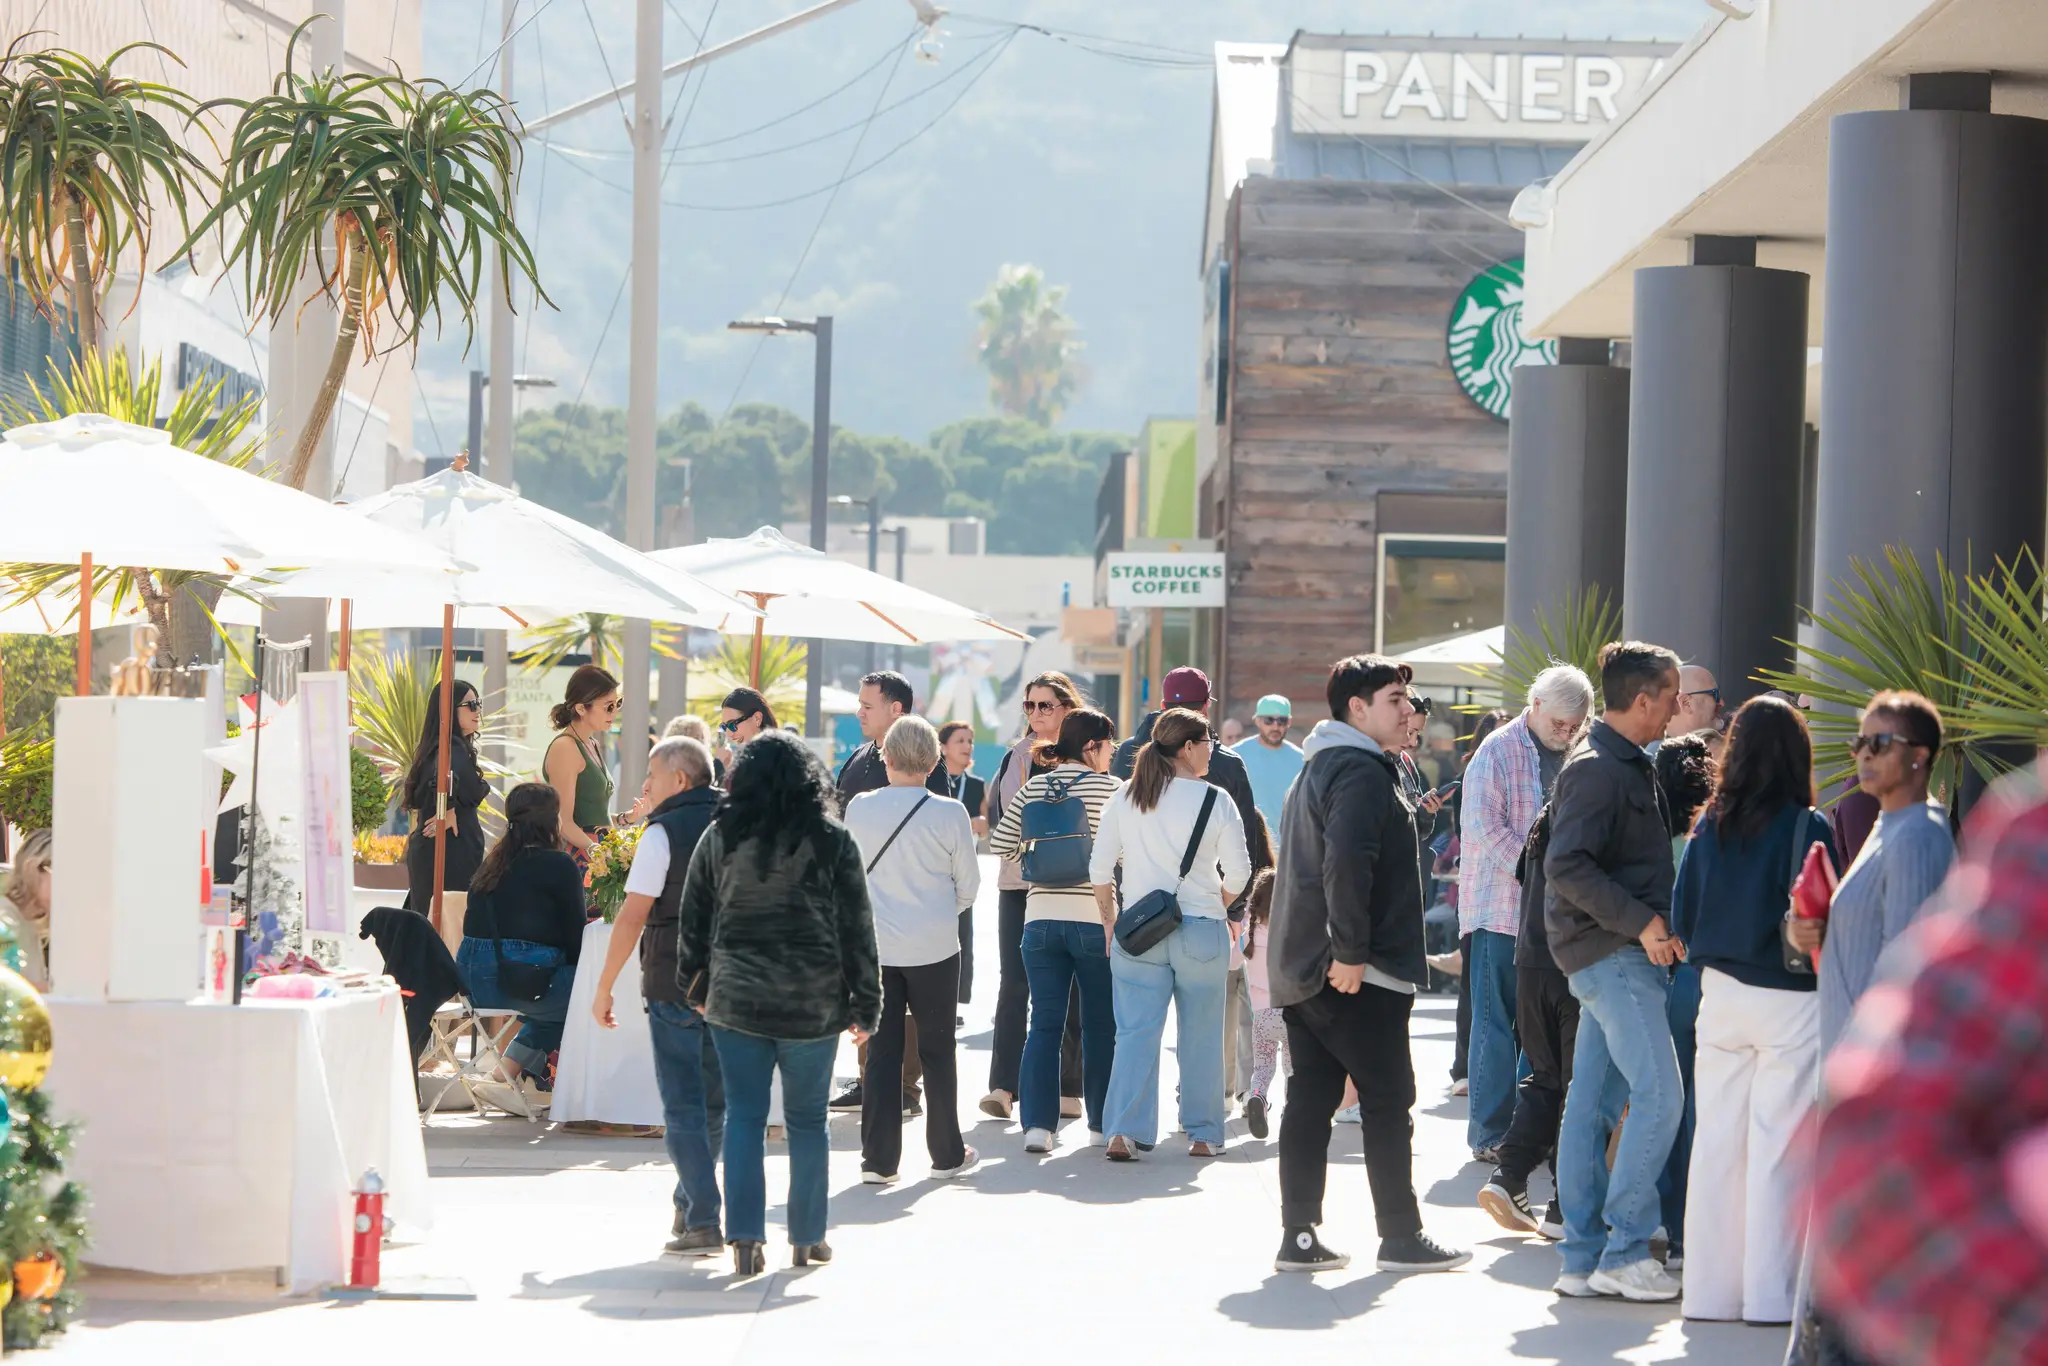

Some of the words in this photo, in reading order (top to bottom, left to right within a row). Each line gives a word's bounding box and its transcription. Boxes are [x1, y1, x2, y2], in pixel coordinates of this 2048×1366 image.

[1111, 566, 1223, 578] STARBUCKS
[1132, 581, 1201, 593] COFFEE
[507, 678, 541, 690] OTOS
